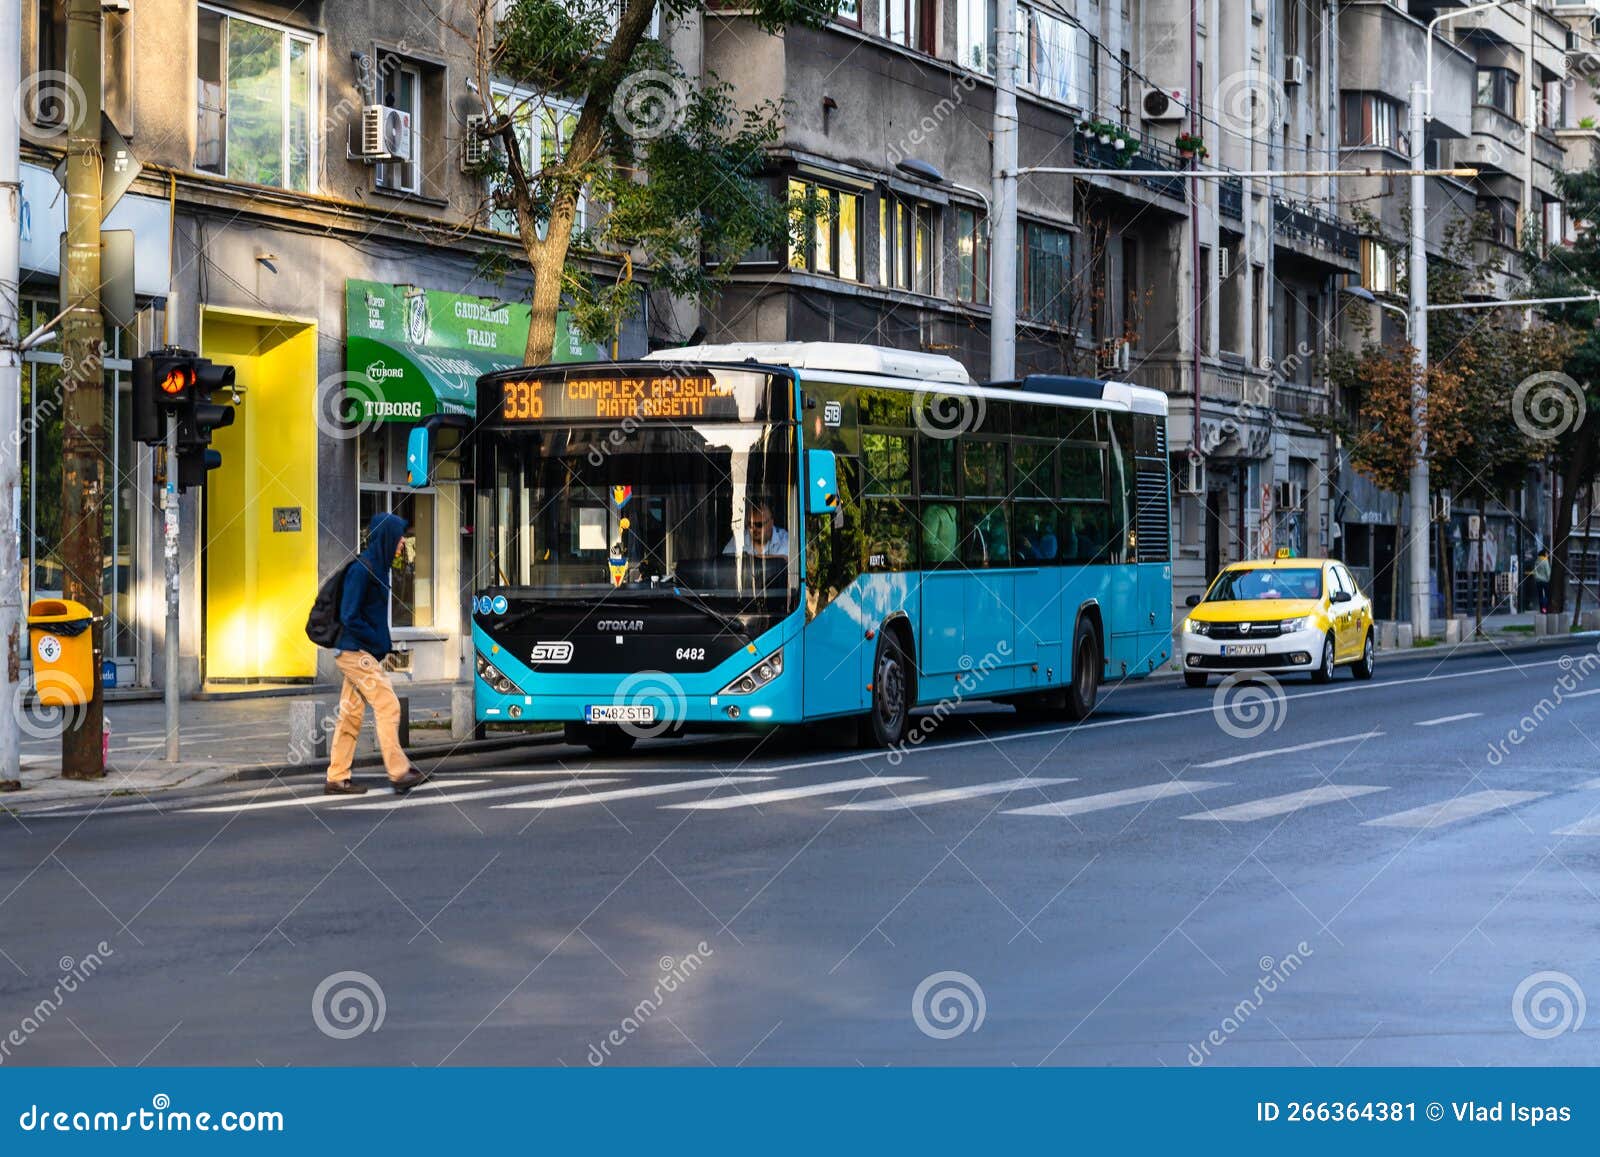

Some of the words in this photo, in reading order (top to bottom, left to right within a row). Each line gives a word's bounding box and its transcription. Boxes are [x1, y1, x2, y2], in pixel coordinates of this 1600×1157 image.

[455, 301, 509, 325] GAUDEAMUS
[466, 328, 497, 348] TRADE
[370, 367, 404, 379] TUBORG
[568, 379, 646, 399] COMPLEX
[365, 400, 422, 418] TUBORG
[503, 381, 544, 419] 336
[596, 398, 638, 417] PIATA
[643, 396, 703, 417] ROSETTI
[825, 403, 841, 424] STB
[597, 620, 644, 631] OTOKAR
[531, 643, 573, 662] STB
[676, 648, 705, 660] 6482
